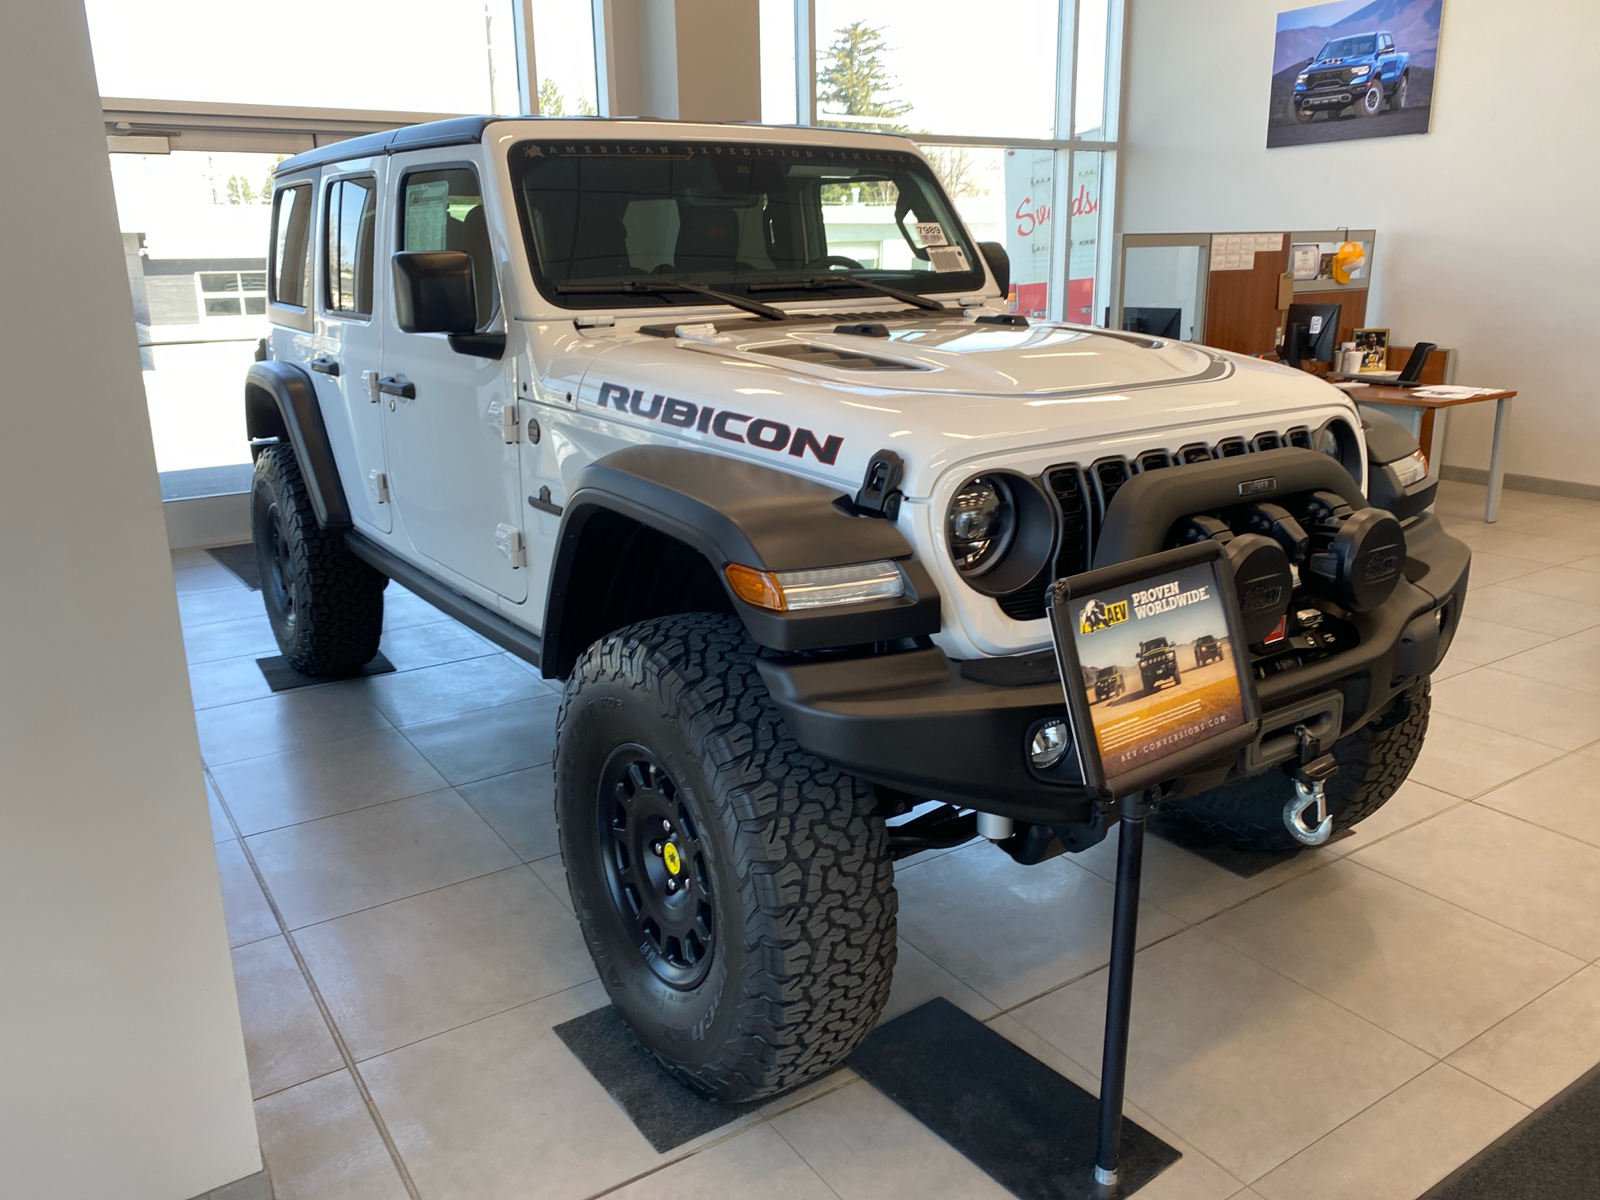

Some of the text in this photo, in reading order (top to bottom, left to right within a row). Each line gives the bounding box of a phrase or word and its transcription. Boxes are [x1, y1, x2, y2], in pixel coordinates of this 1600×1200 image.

[550, 146, 916, 164] AMERICAN EXPEDITION VEHICLES
[916, 226, 941, 235] 7989
[597, 381, 845, 466] RUBICON
[1131, 581, 1179, 607] PROVEN
[1106, 603, 1127, 624] AEV
[1120, 714, 1227, 763] AEV-CONVERSIONS.COM
